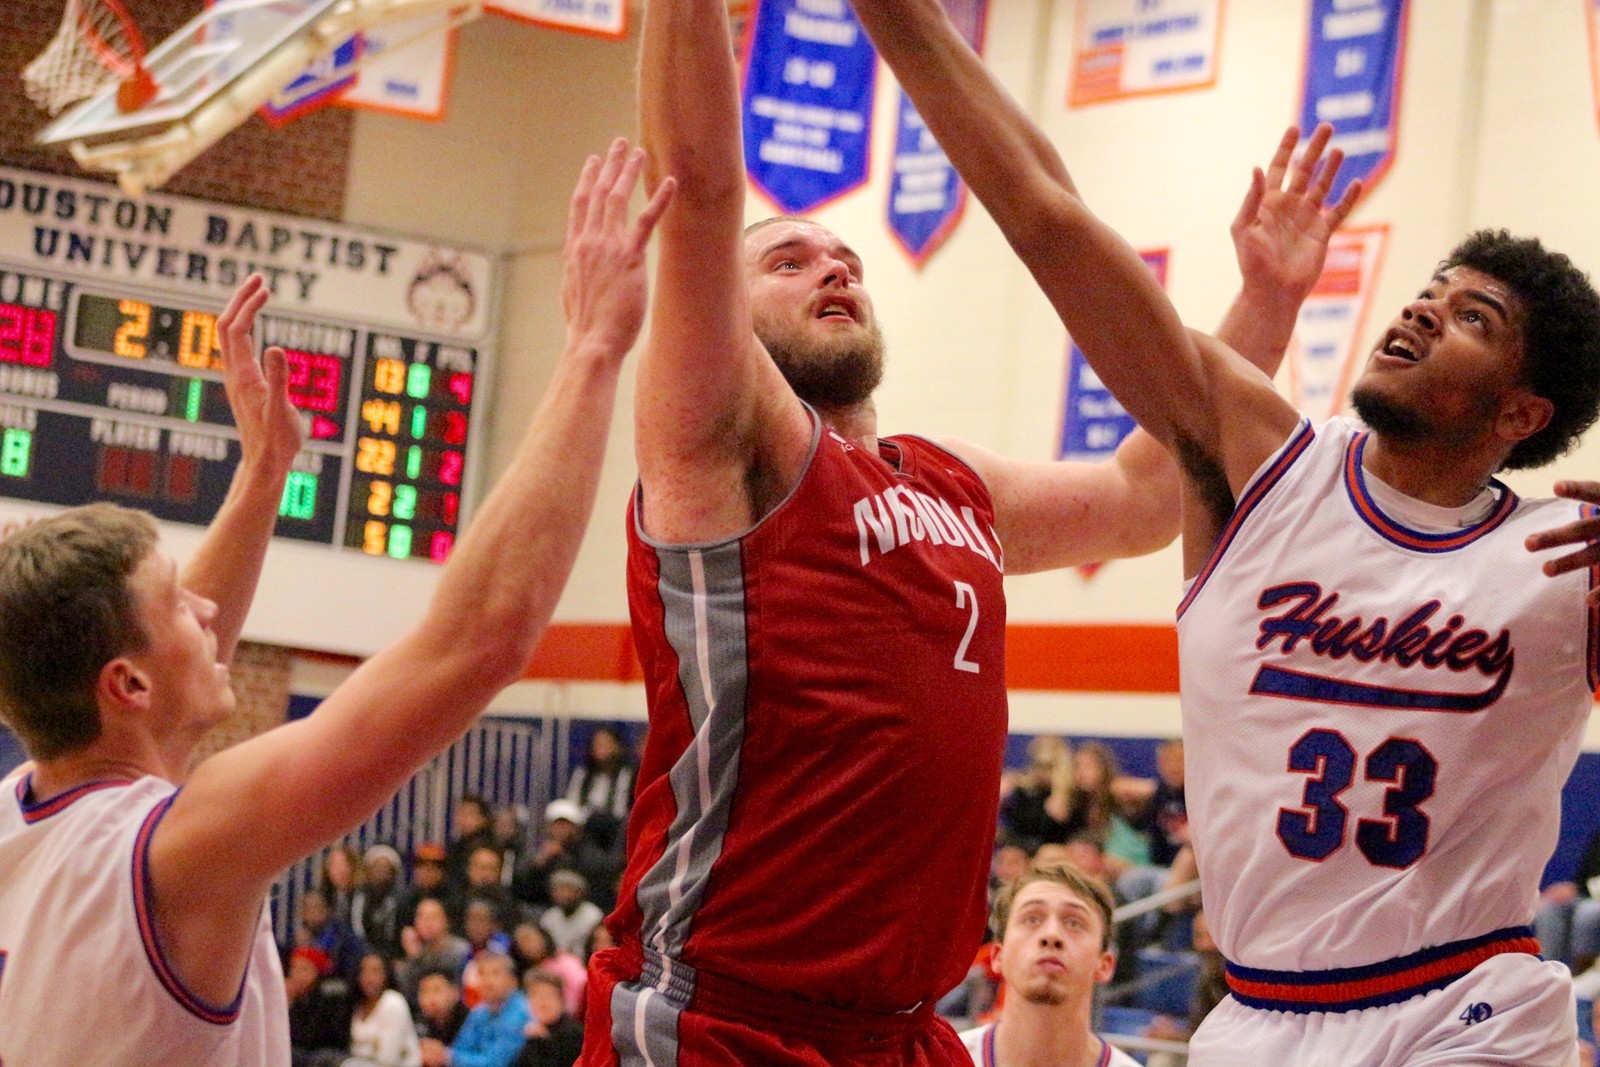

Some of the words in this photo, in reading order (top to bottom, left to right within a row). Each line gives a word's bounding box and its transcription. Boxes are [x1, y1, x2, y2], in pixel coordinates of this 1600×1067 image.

[206, 214, 397, 275] BAPTIST
[411, 404, 427, 439] 1
[406, 444, 422, 480] 1
[367, 480, 393, 517] 2
[392, 483, 418, 520] 2
[953, 580, 980, 674] 2
[1256, 580, 1514, 678] Huskies
[1274, 727, 1439, 871] 33
